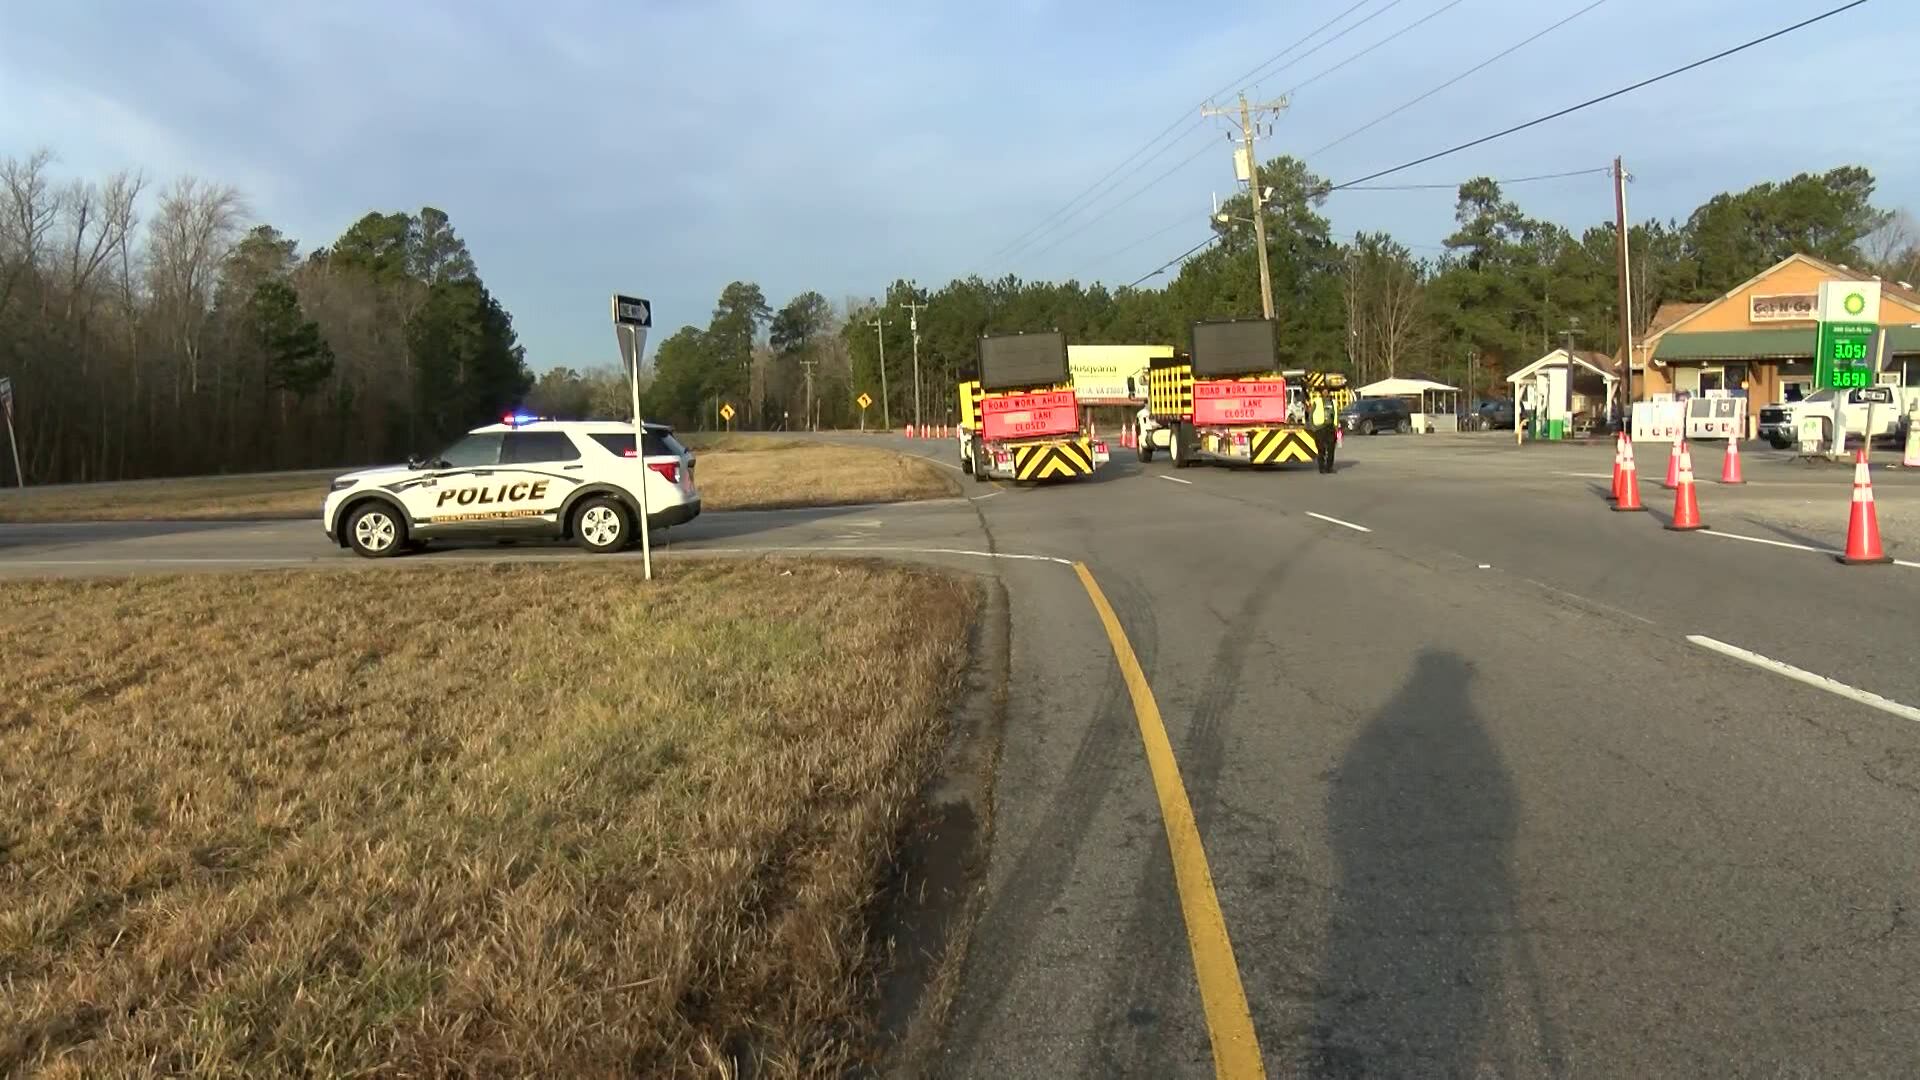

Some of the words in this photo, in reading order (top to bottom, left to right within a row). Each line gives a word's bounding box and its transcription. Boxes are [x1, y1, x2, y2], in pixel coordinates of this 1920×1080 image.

[1199, 386, 1220, 396] ROAD
[1226, 385, 1247, 395] WORK
[1253, 384, 1278, 394] AHEAD
[988, 400, 1009, 410] ROAD
[1014, 398, 1036, 408] WORK
[1042, 396, 1068, 405] AHEAD
[1243, 399, 1262, 408] LANE
[1033, 411, 1052, 420] LANE
[1224, 409, 1255, 418] CLOSED
[1015, 423, 1046, 432] CLOSED
[436, 479, 550, 508] POLICE
